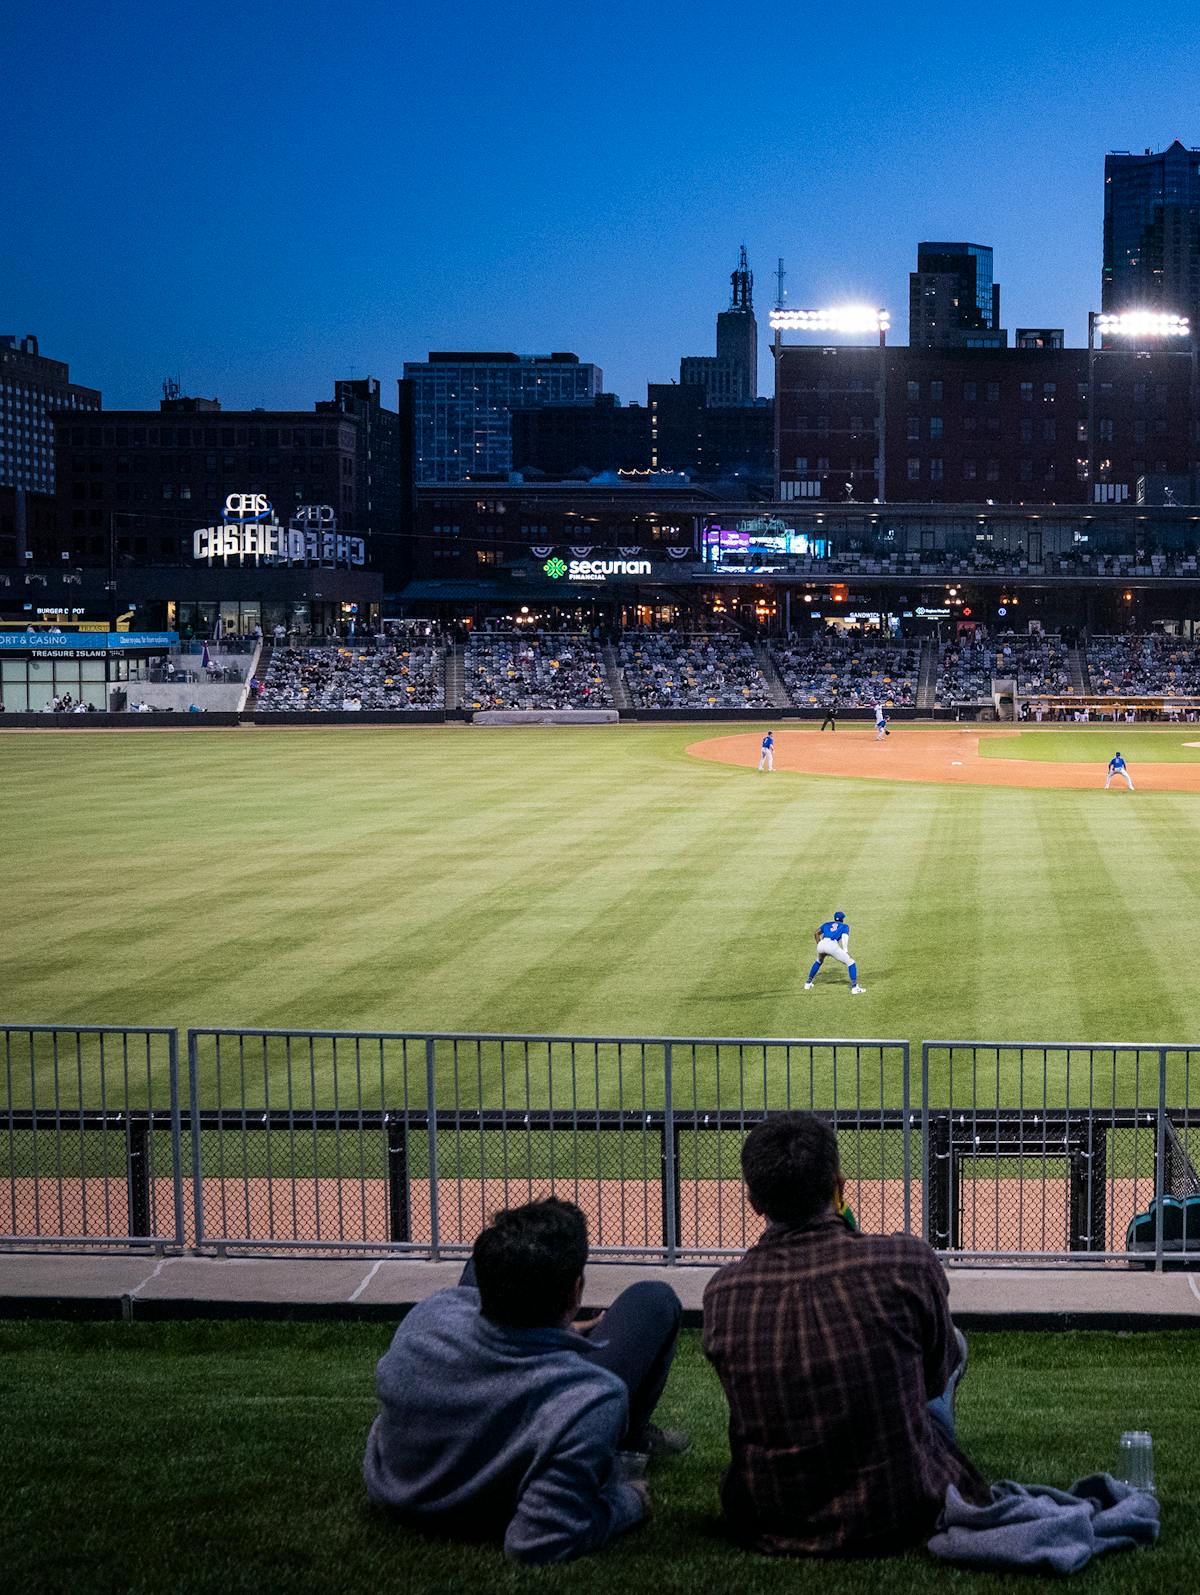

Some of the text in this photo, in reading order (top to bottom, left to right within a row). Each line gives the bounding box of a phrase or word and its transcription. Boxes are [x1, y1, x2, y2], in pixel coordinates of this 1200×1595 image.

[225, 493, 270, 511] CHS
[193, 525, 240, 559] CHS
[244, 524, 305, 558] FIELD
[569, 560, 651, 574] securian
[20, 636, 27, 644] &
[29, 635, 67, 644] CASINO
